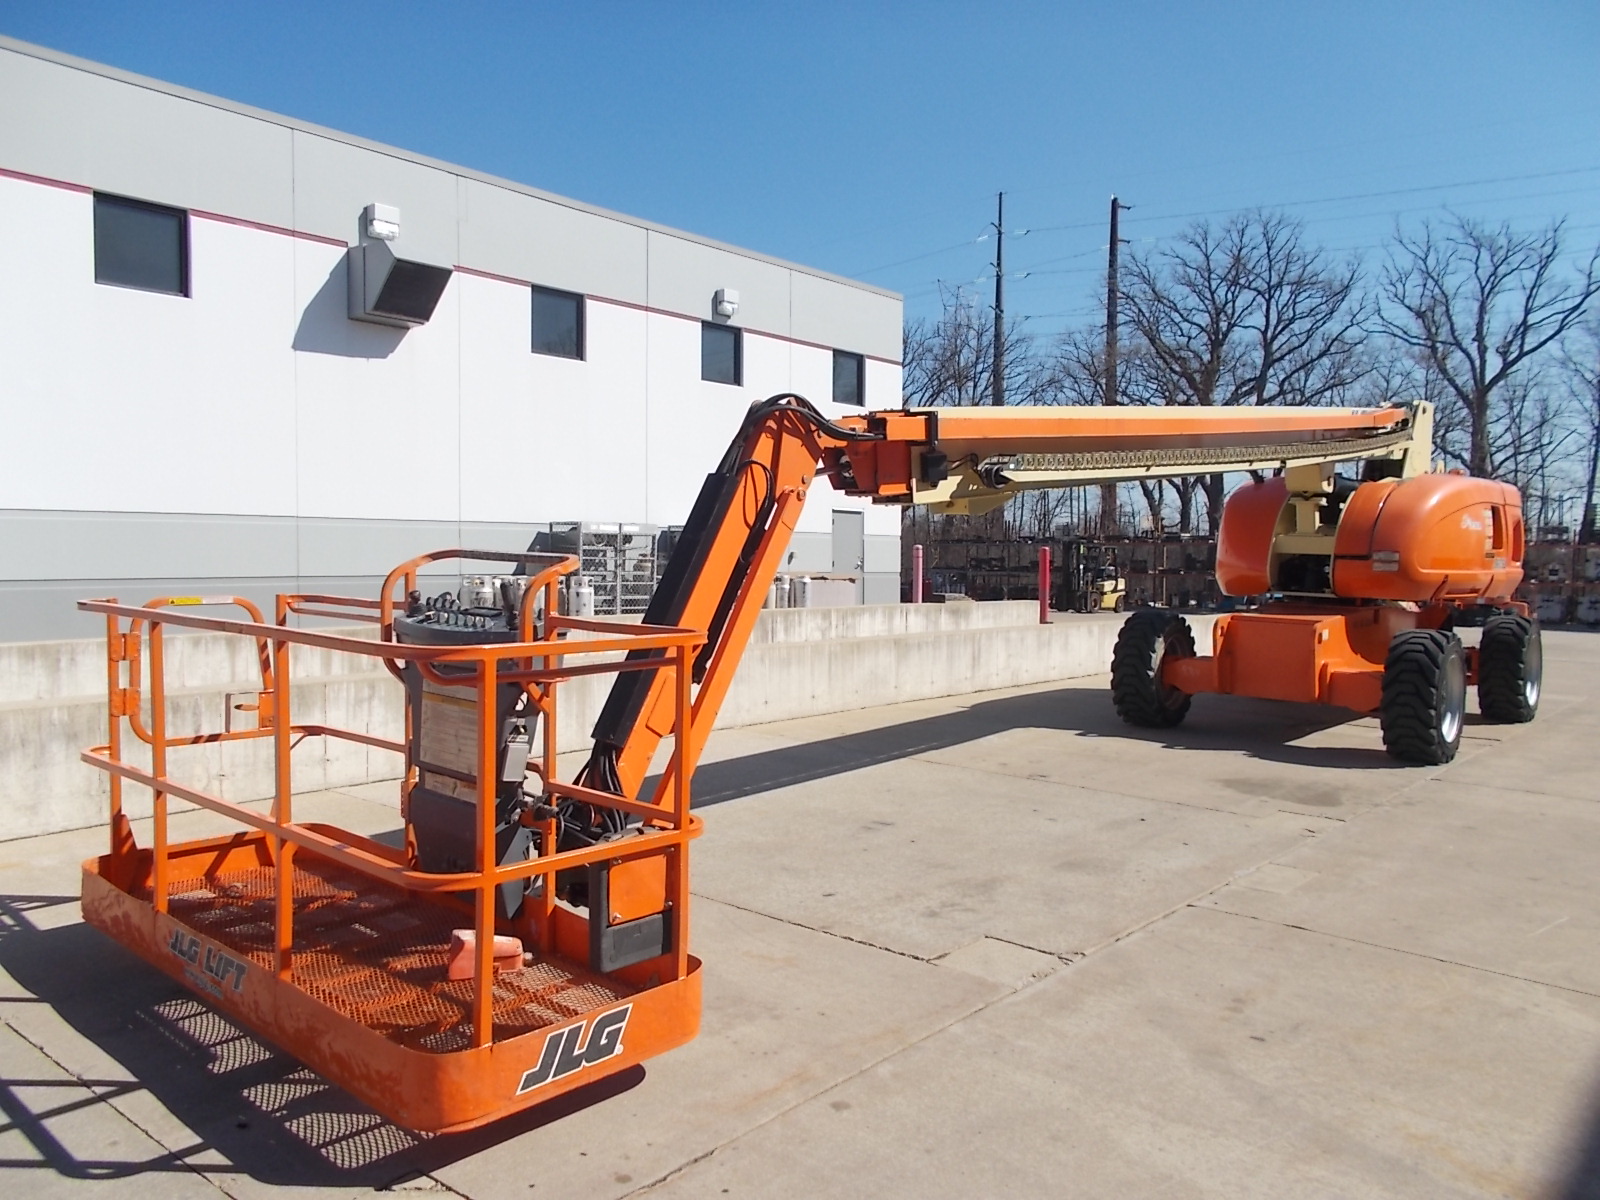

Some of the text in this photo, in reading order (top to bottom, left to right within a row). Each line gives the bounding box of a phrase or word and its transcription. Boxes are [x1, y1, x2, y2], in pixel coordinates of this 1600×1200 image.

[169, 928, 202, 967] JLG
[203, 945, 248, 992] LIFT
[516, 1002, 634, 1096] JLG
